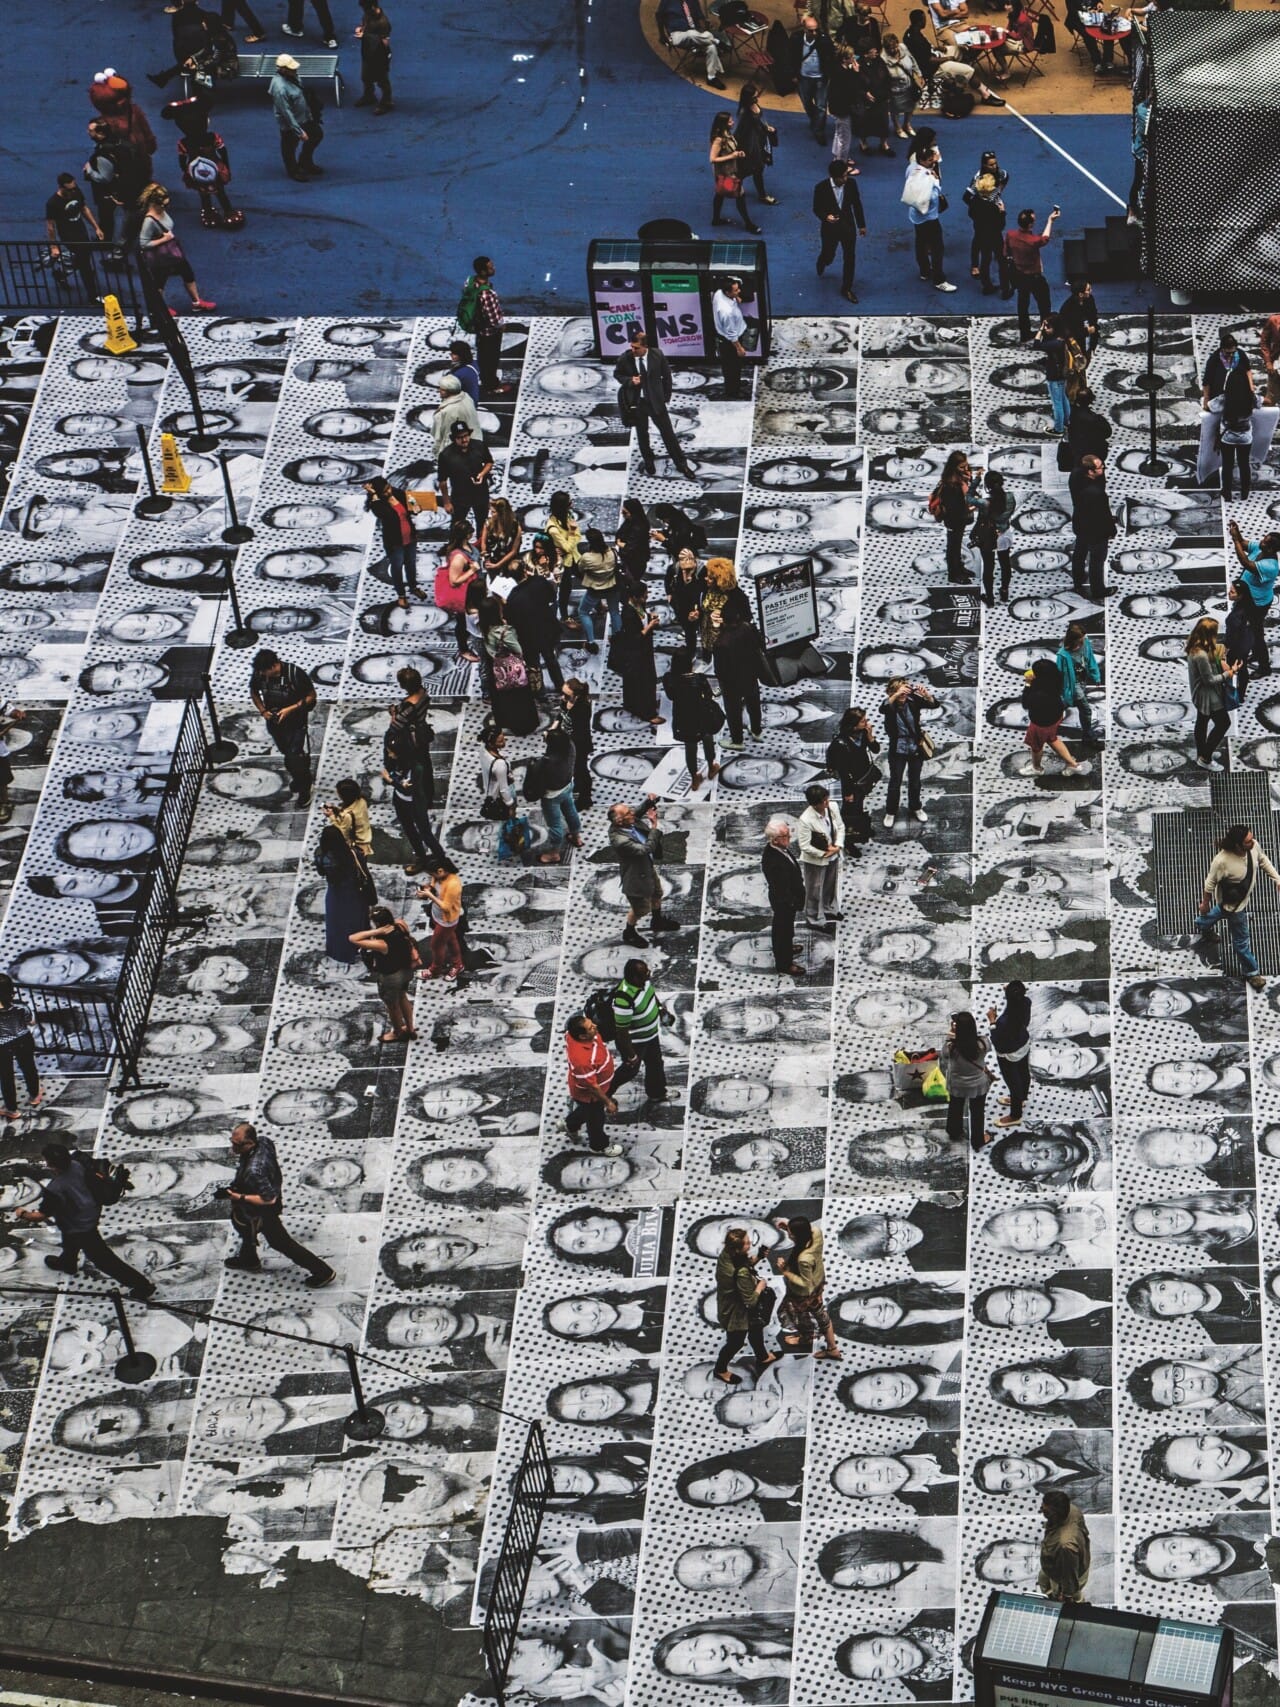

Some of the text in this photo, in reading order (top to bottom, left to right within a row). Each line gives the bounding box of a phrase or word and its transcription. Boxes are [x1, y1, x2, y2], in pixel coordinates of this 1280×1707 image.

[600, 312, 635, 324] TODAY
[765, 599, 787, 610] PASTE
[789, 592, 809, 602] HERE
[636, 1241, 656, 1277] JULIA
[1002, 1675, 1036, 1688] Keep
[1040, 1681, 1068, 1692] NYC
[1072, 1686, 1112, 1699] Green
[1116, 1695, 1141, 1704] and
